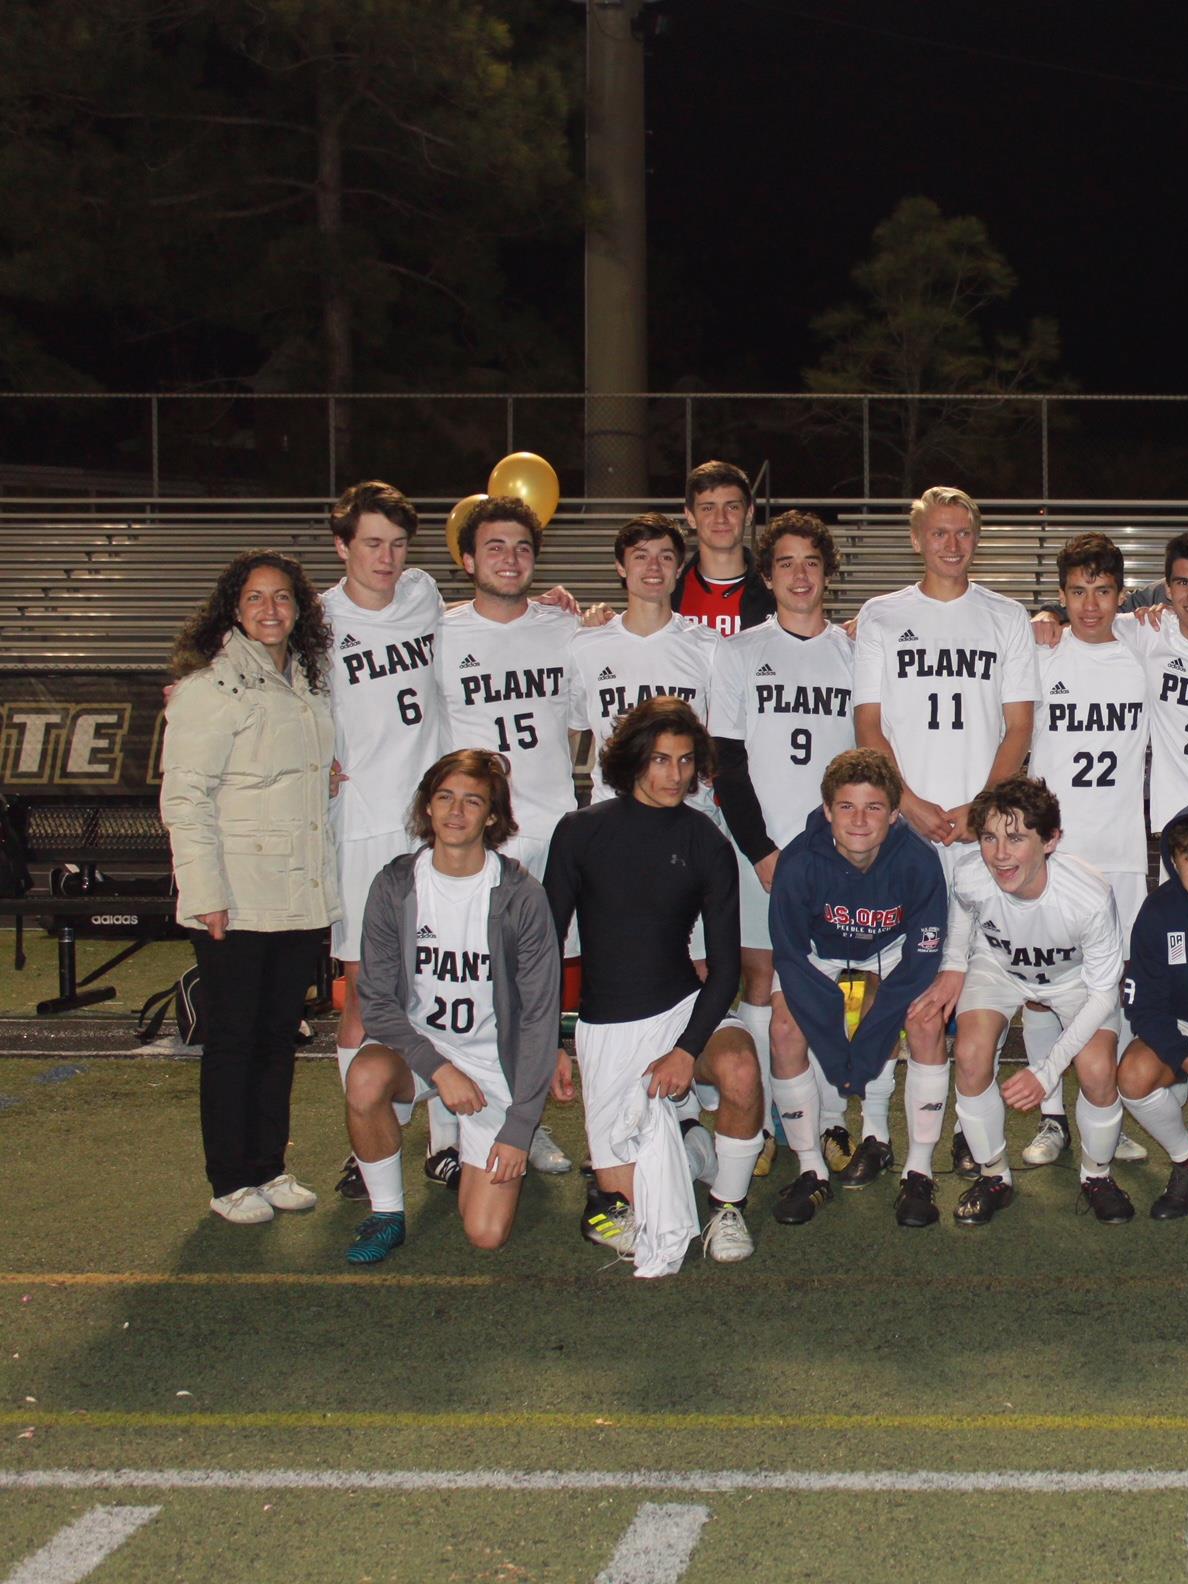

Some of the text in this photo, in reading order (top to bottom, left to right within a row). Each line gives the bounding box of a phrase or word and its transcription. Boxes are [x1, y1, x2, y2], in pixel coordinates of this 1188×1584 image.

[342, 633, 435, 685] PLANT
[896, 648, 997, 681] PLANT
[460, 666, 564, 706] PLANT
[755, 684, 852, 718] PLANT
[396, 687, 423, 726] 6
[928, 692, 964, 730] 11
[1048, 702, 1143, 732] PLANT
[0, 703, 131, 784] TE
[494, 712, 539, 752] 15
[790, 728, 812, 766] 9
[1071, 751, 1118, 788] 22
[91, 914, 139, 925] adidas
[1170, 934, 1183, 948] DA
[426, 995, 475, 1034] 20
